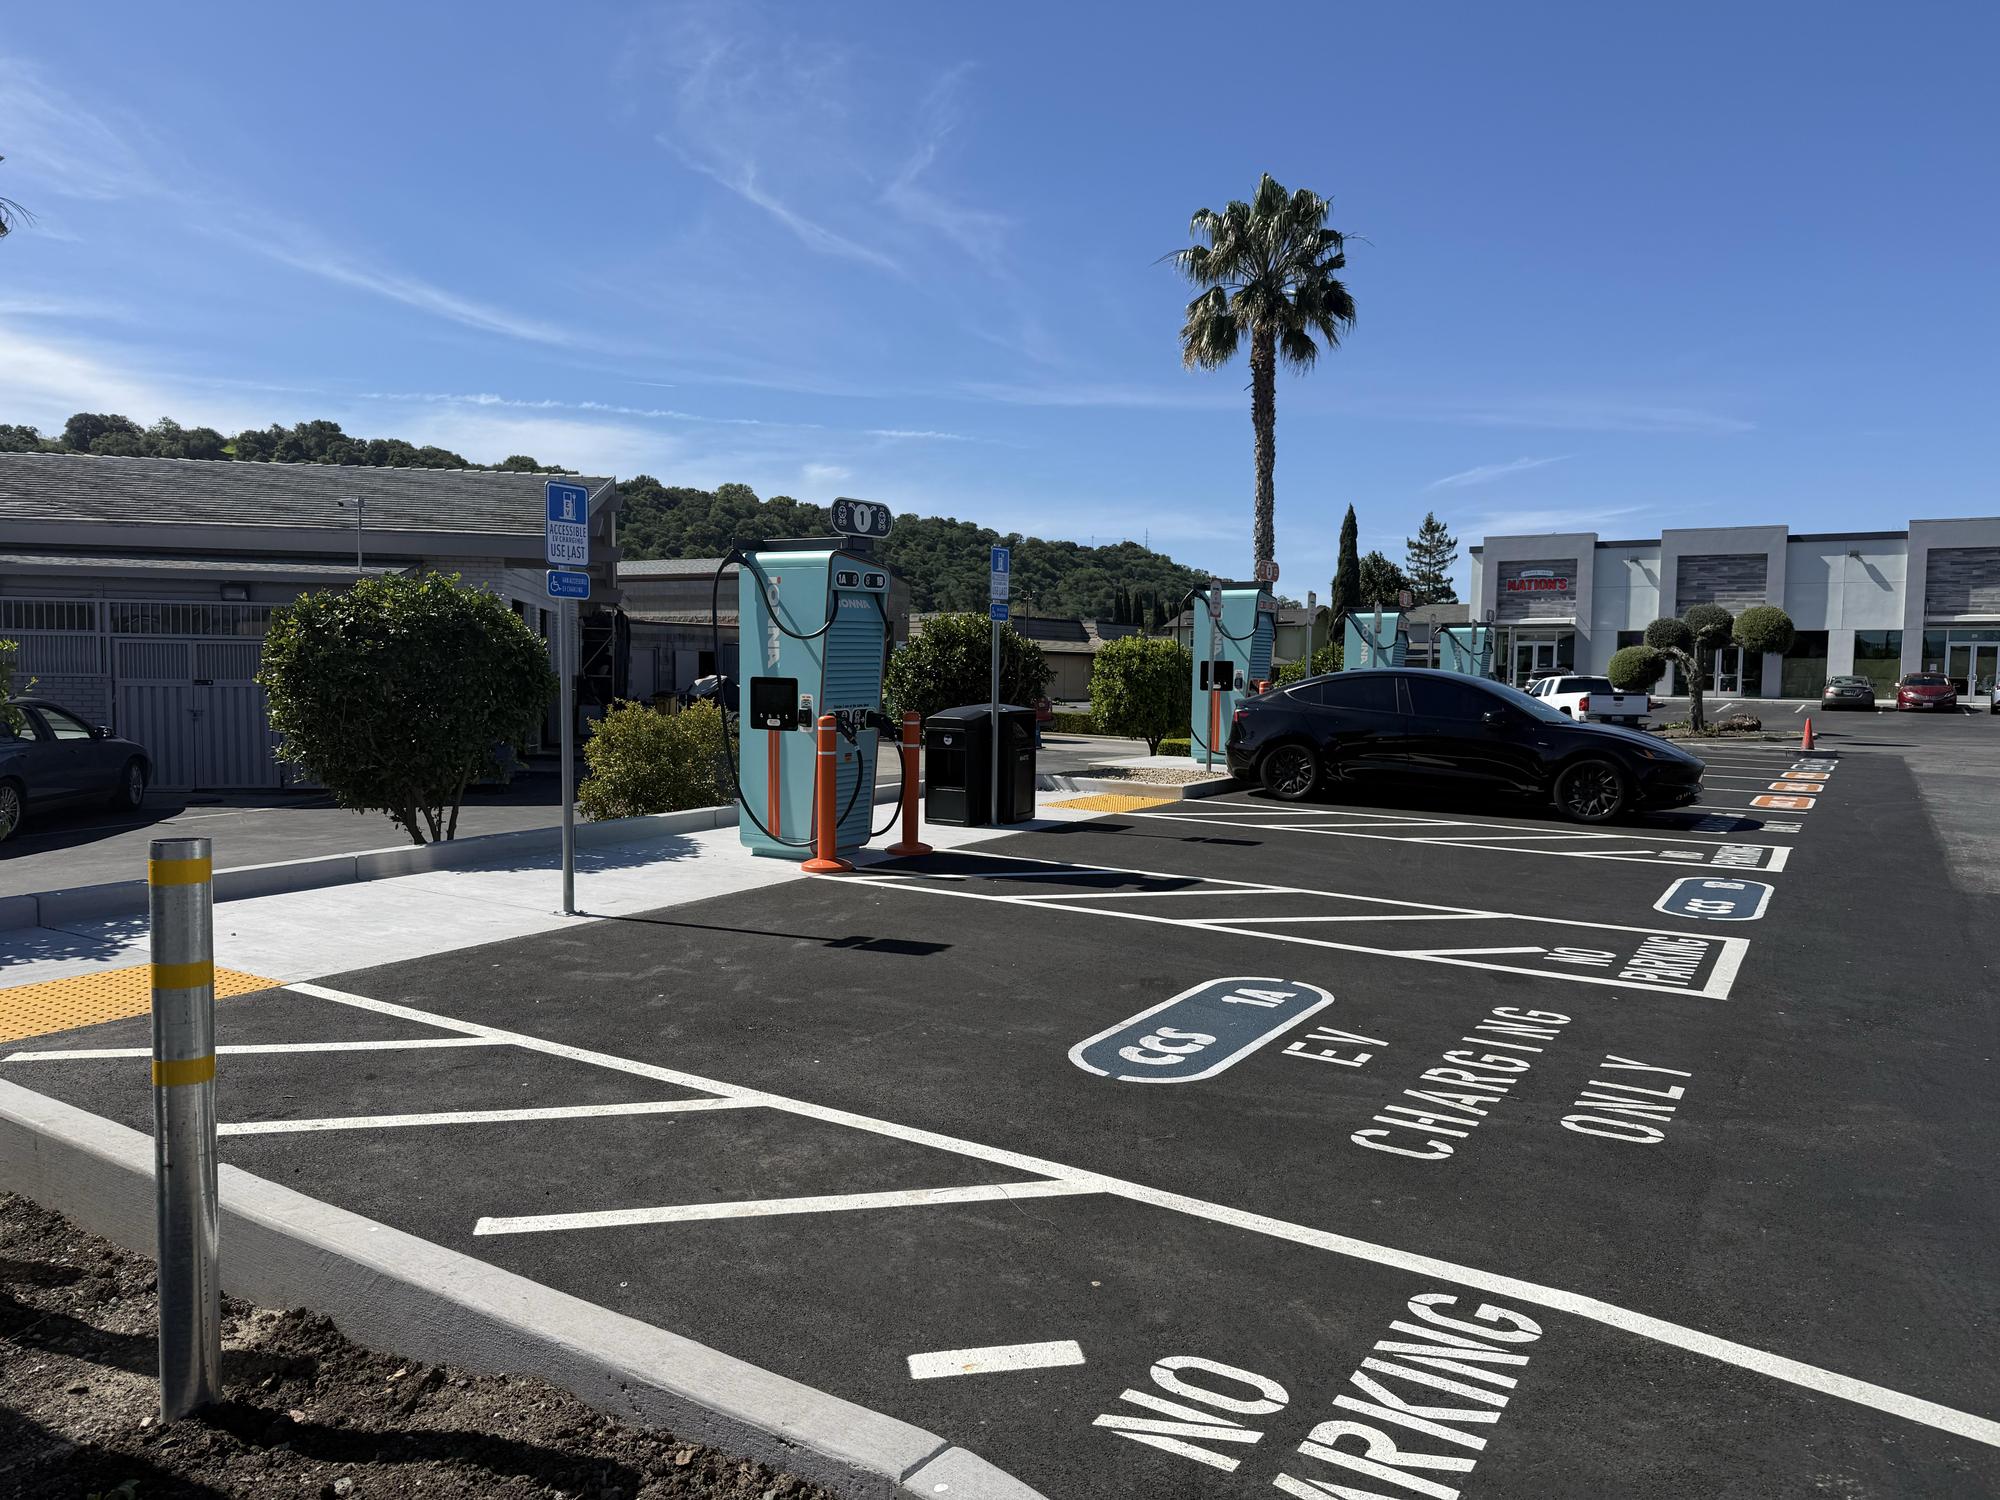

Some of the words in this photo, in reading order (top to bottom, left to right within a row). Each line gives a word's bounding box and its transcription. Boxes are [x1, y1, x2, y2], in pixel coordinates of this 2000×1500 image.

[549, 523, 586, 538] ACCESSIBLE
[860, 510, 865, 526] 1
[550, 543, 566, 557] USE
[567, 545, 585, 559] LAST
[559, 536, 583, 545] CHARGING
[1506, 577, 1568, 592] NATION'S
[1543, 946, 1617, 967] NO
[1618, 936, 1710, 986] PARKING
[1118, 1026, 1217, 1065] CCS
[1220, 988, 1297, 1008] 1A
[1281, 1026, 1389, 1067] EV
[1350, 1006, 1572, 1160] CHARGING
[1560, 1054, 1692, 1144] ONLY
[1092, 1355, 1290, 1472] NO
[1272, 1293, 1543, 1500] RKING
